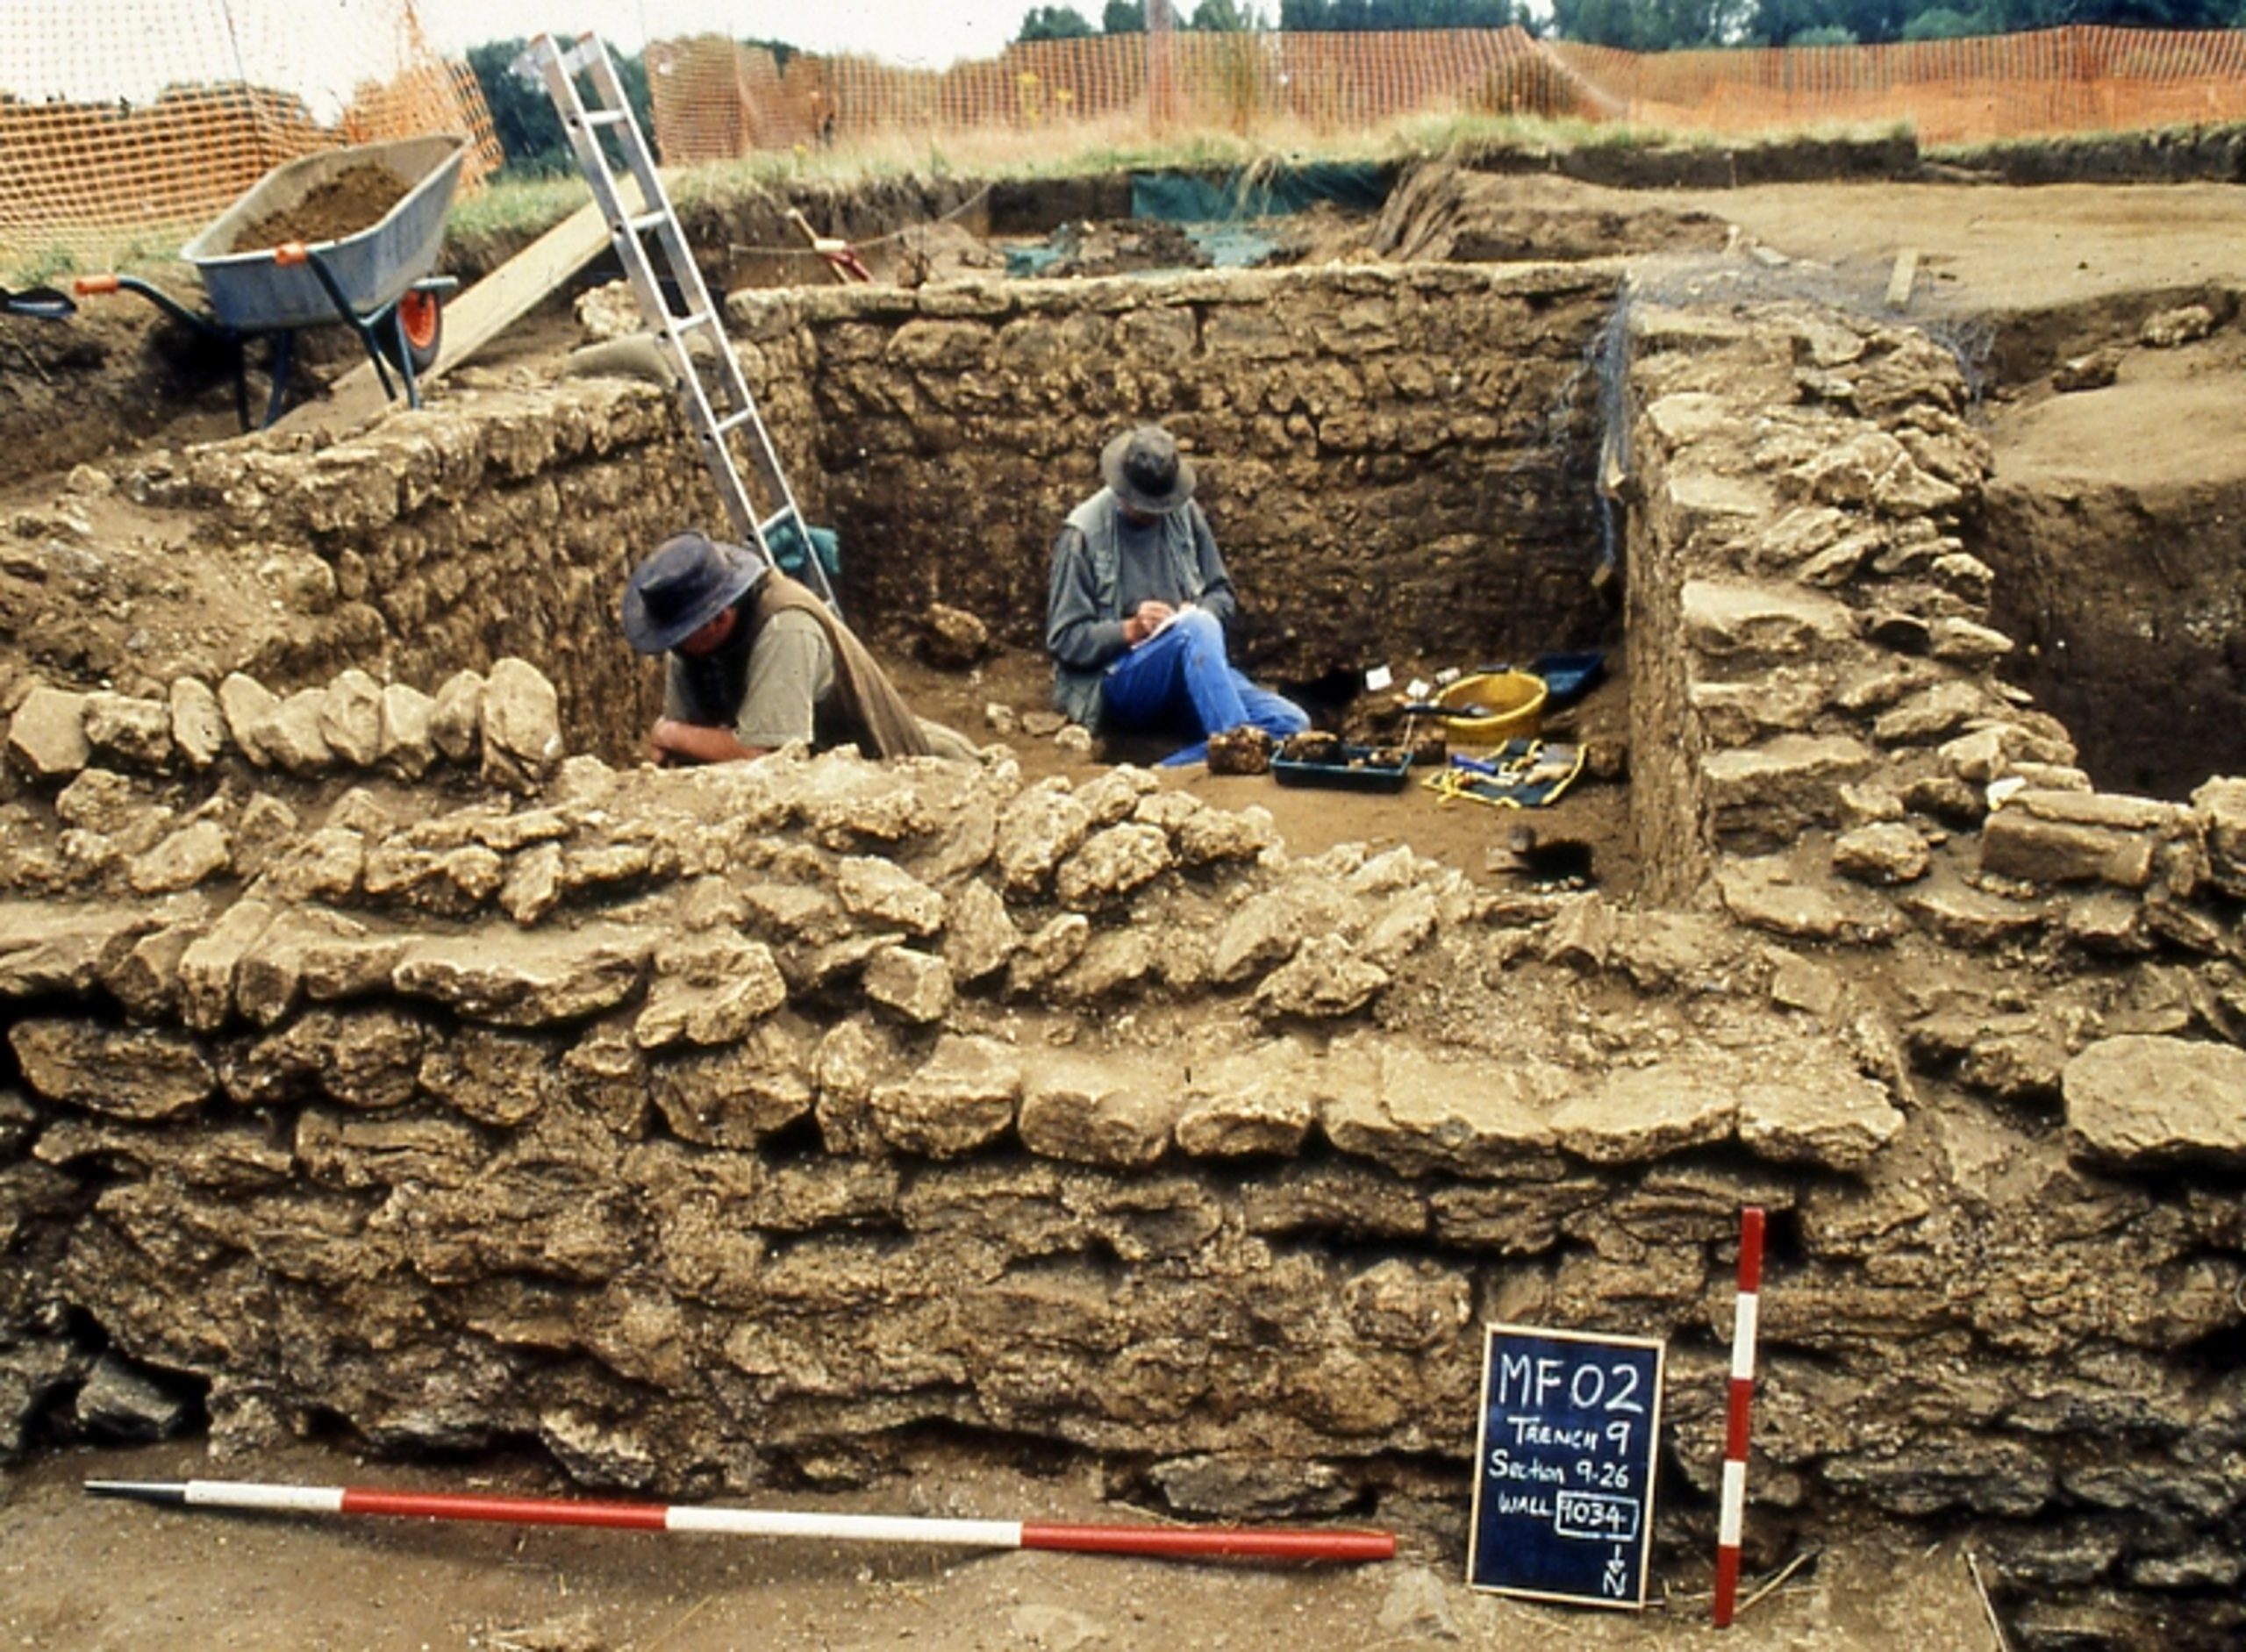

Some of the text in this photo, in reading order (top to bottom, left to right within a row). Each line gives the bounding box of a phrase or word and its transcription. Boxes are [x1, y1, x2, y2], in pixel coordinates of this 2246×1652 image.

[1606, 1420, 1631, 1456] 9
[1489, 1448, 1629, 1489] Section 9.26
[1498, 1491, 1553, 1517] WALL
[1602, 1571, 1627, 1596] N
